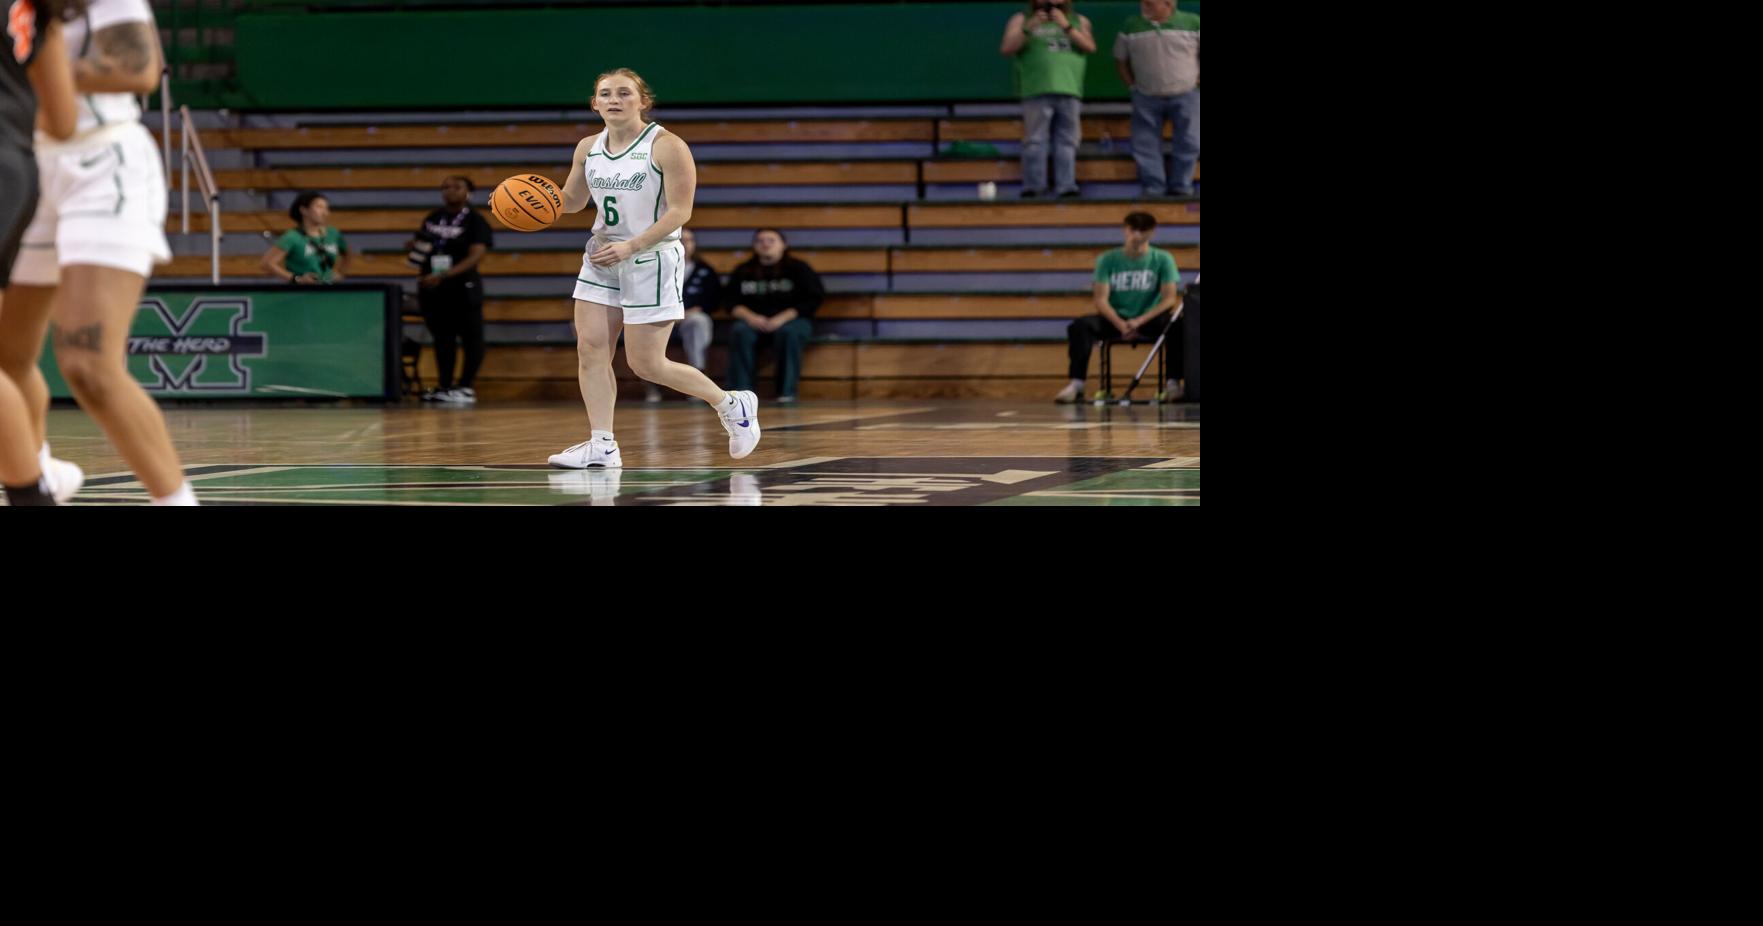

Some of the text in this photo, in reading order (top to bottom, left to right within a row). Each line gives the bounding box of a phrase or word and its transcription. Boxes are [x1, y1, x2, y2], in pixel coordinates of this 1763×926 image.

[603, 196, 620, 226] 6
[129, 337, 231, 353] THE HERD
